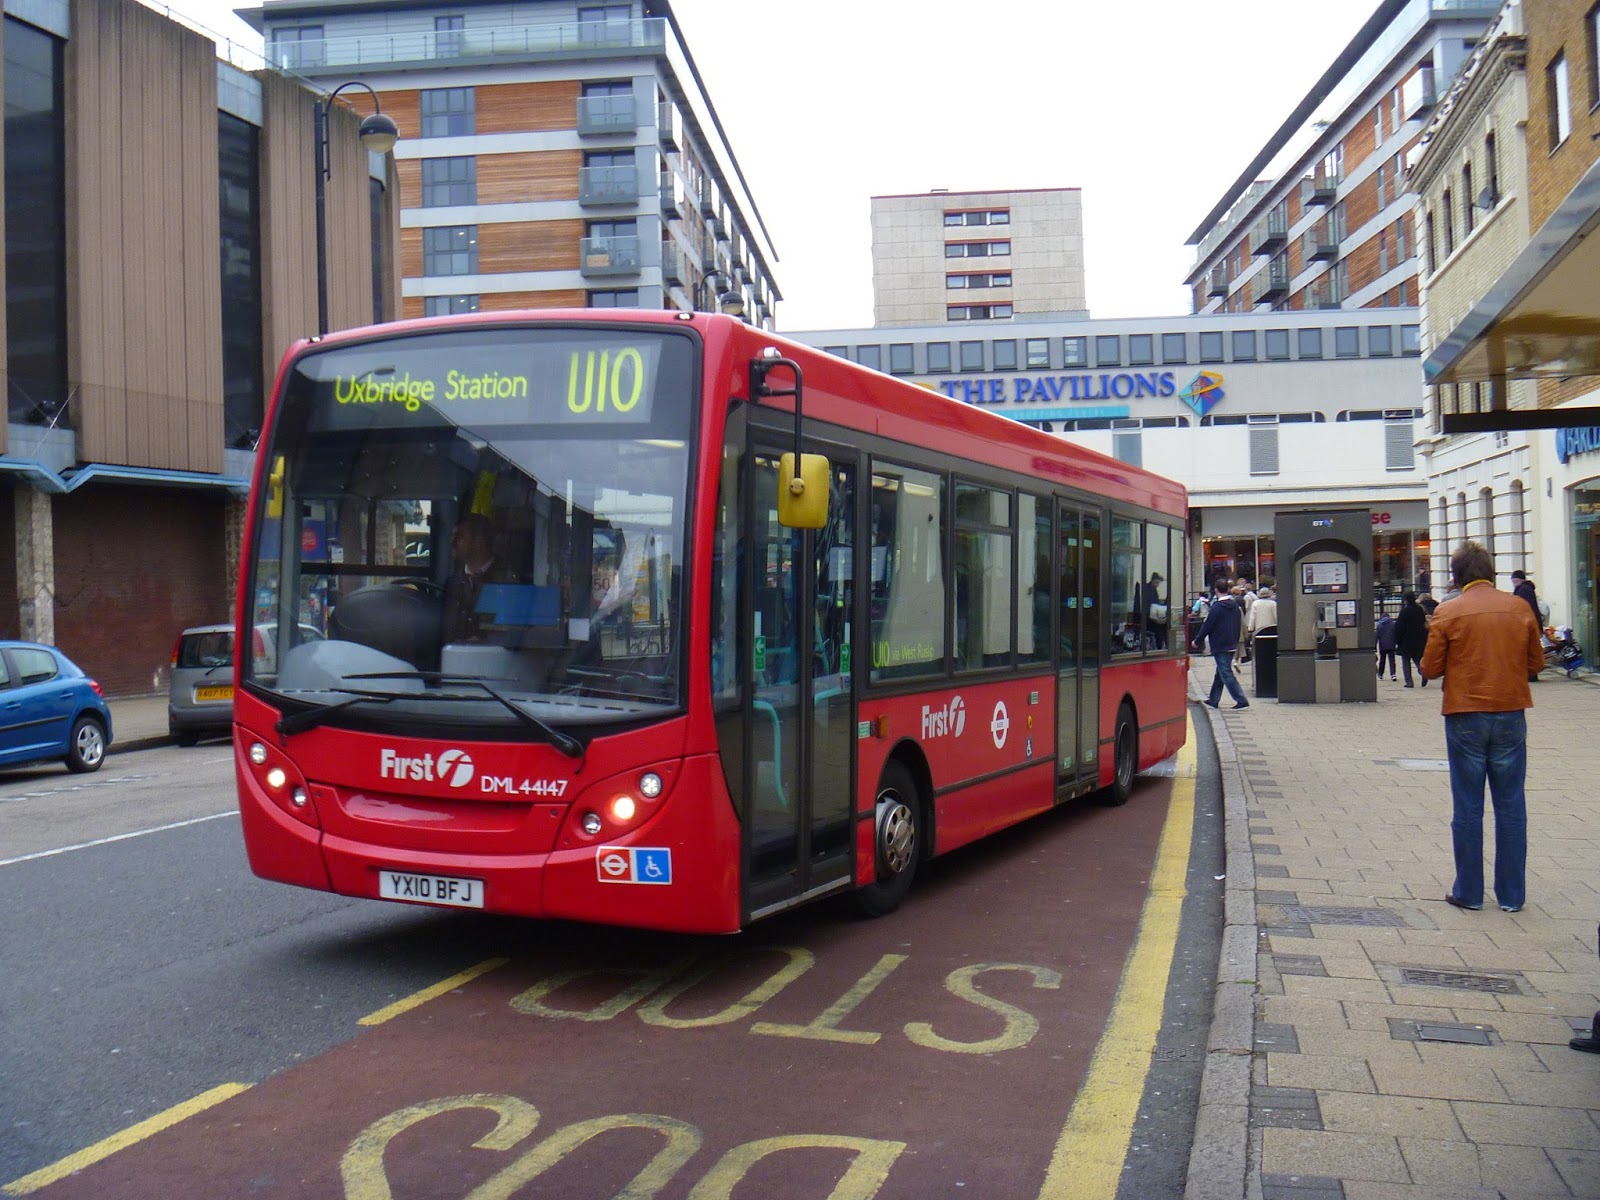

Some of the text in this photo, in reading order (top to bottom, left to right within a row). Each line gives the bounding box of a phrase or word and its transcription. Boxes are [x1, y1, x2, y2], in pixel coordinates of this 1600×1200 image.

[335, 369, 528, 412] Uxbridge Station
[567, 346, 644, 414] U10
[940, 371, 1176, 404] THE PAVILIONS
[1371, 511, 1392, 525] se
[922, 703, 949, 740] First
[381, 748, 434, 782] First
[391, 874, 472, 902] YX10 BFJ
[508, 946, 1063, 1054] STOP
